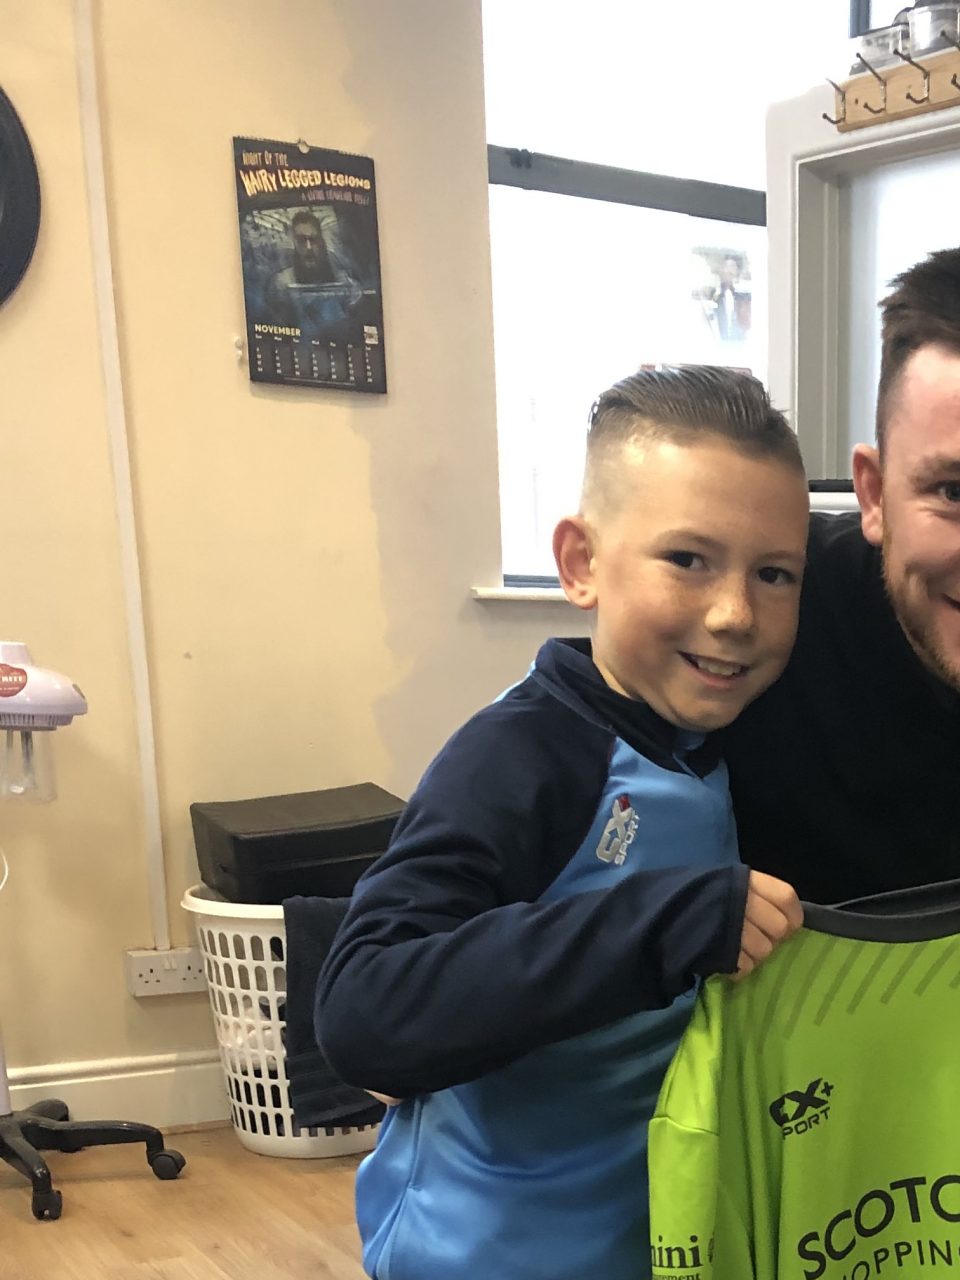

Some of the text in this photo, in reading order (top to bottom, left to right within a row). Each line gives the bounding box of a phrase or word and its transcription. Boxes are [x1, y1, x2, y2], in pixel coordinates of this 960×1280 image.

[240, 169, 371, 197] HAIRY LEGGED LEGIONS
[254, 323, 301, 337] NOVEMBER
[781, 1106, 831, 1141] PORT
